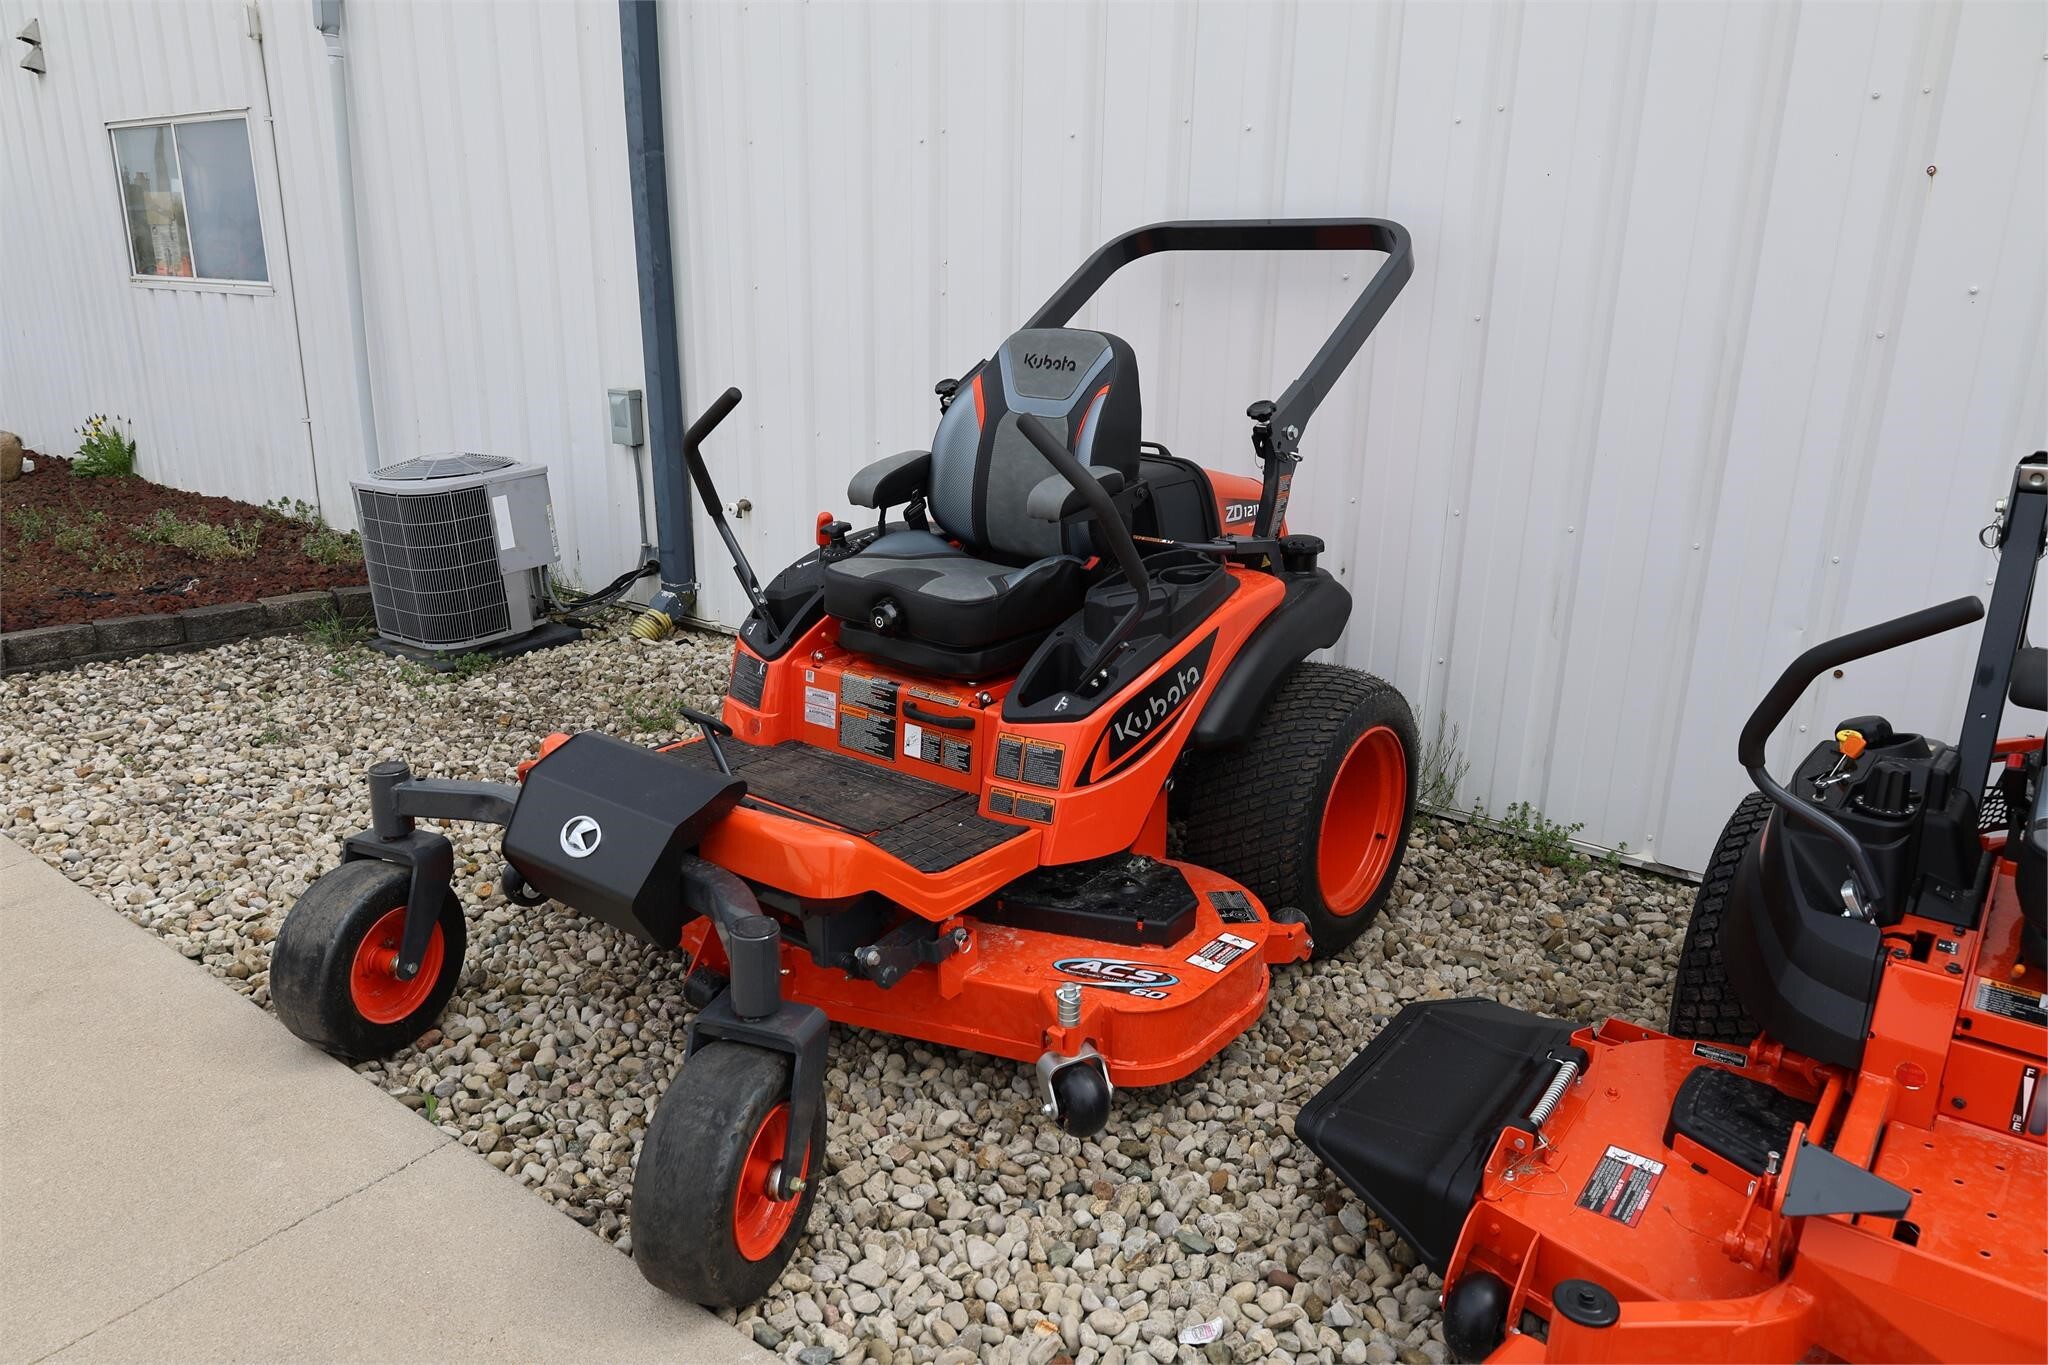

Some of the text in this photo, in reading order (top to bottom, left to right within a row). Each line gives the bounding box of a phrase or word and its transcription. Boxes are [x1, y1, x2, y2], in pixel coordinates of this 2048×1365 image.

[1024, 352, 1076, 372] Kubota
[1114, 666, 1200, 741] Kubota
[1070, 960, 1163, 982] ACS
[1129, 988, 1168, 1000] 60
[2026, 1068, 2036, 1076] F
[2012, 1122, 2022, 1132] E
